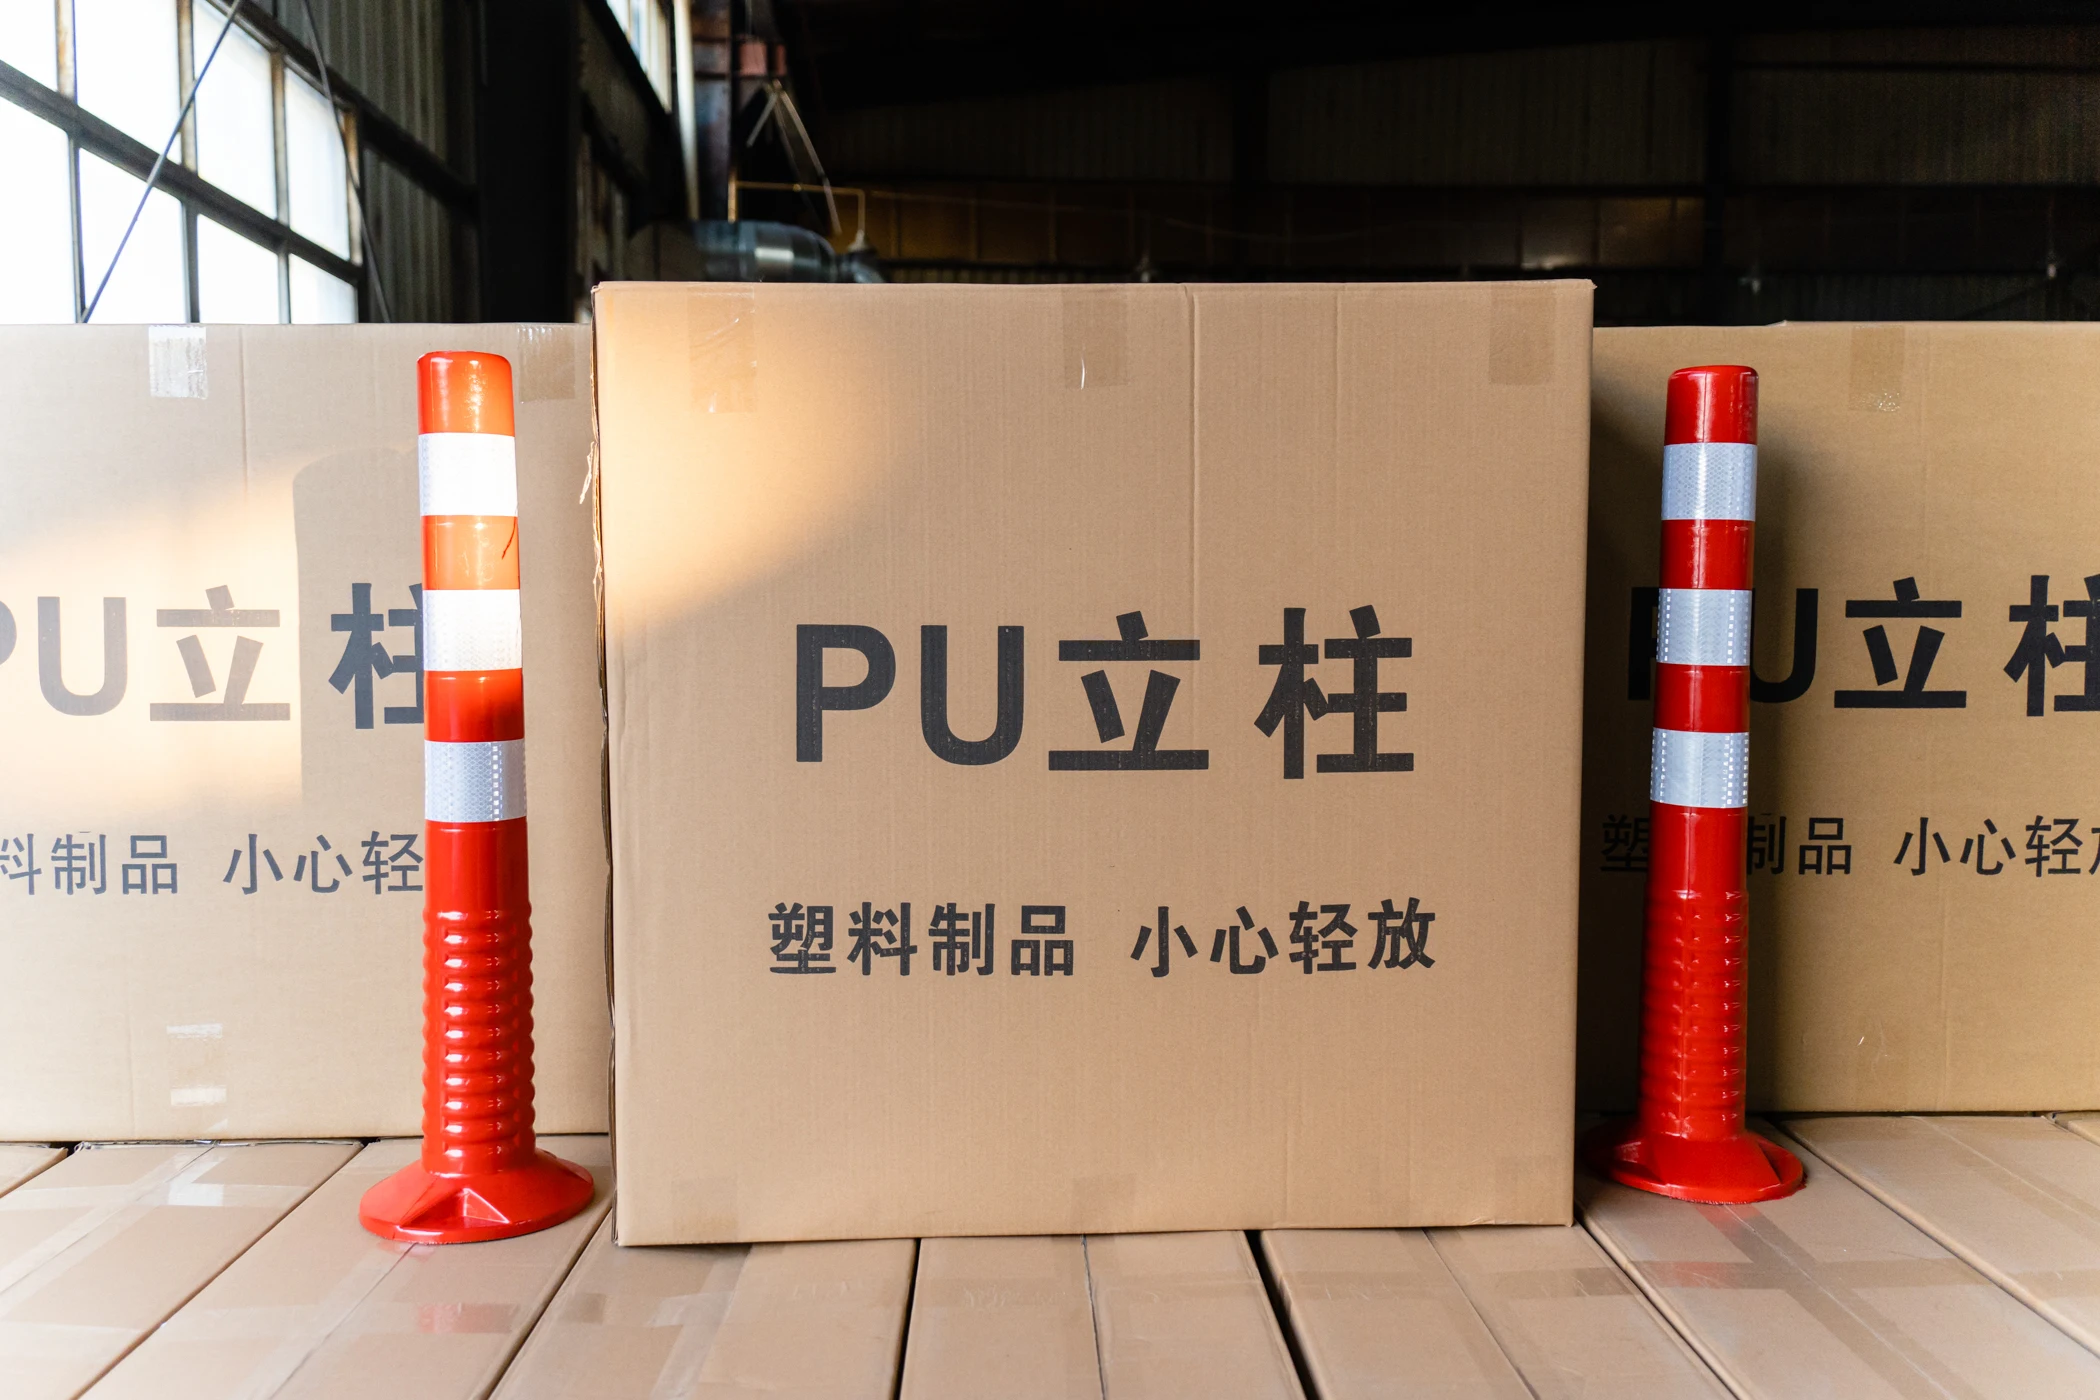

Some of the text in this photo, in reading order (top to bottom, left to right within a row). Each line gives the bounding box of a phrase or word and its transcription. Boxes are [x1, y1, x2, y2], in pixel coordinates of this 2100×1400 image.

[0, 583, 424, 730] U立柱
[1600, 813, 2100, 877] 塑制品 小心轻
[768, 896, 1437, 978] 塑料制品 小心轻放
